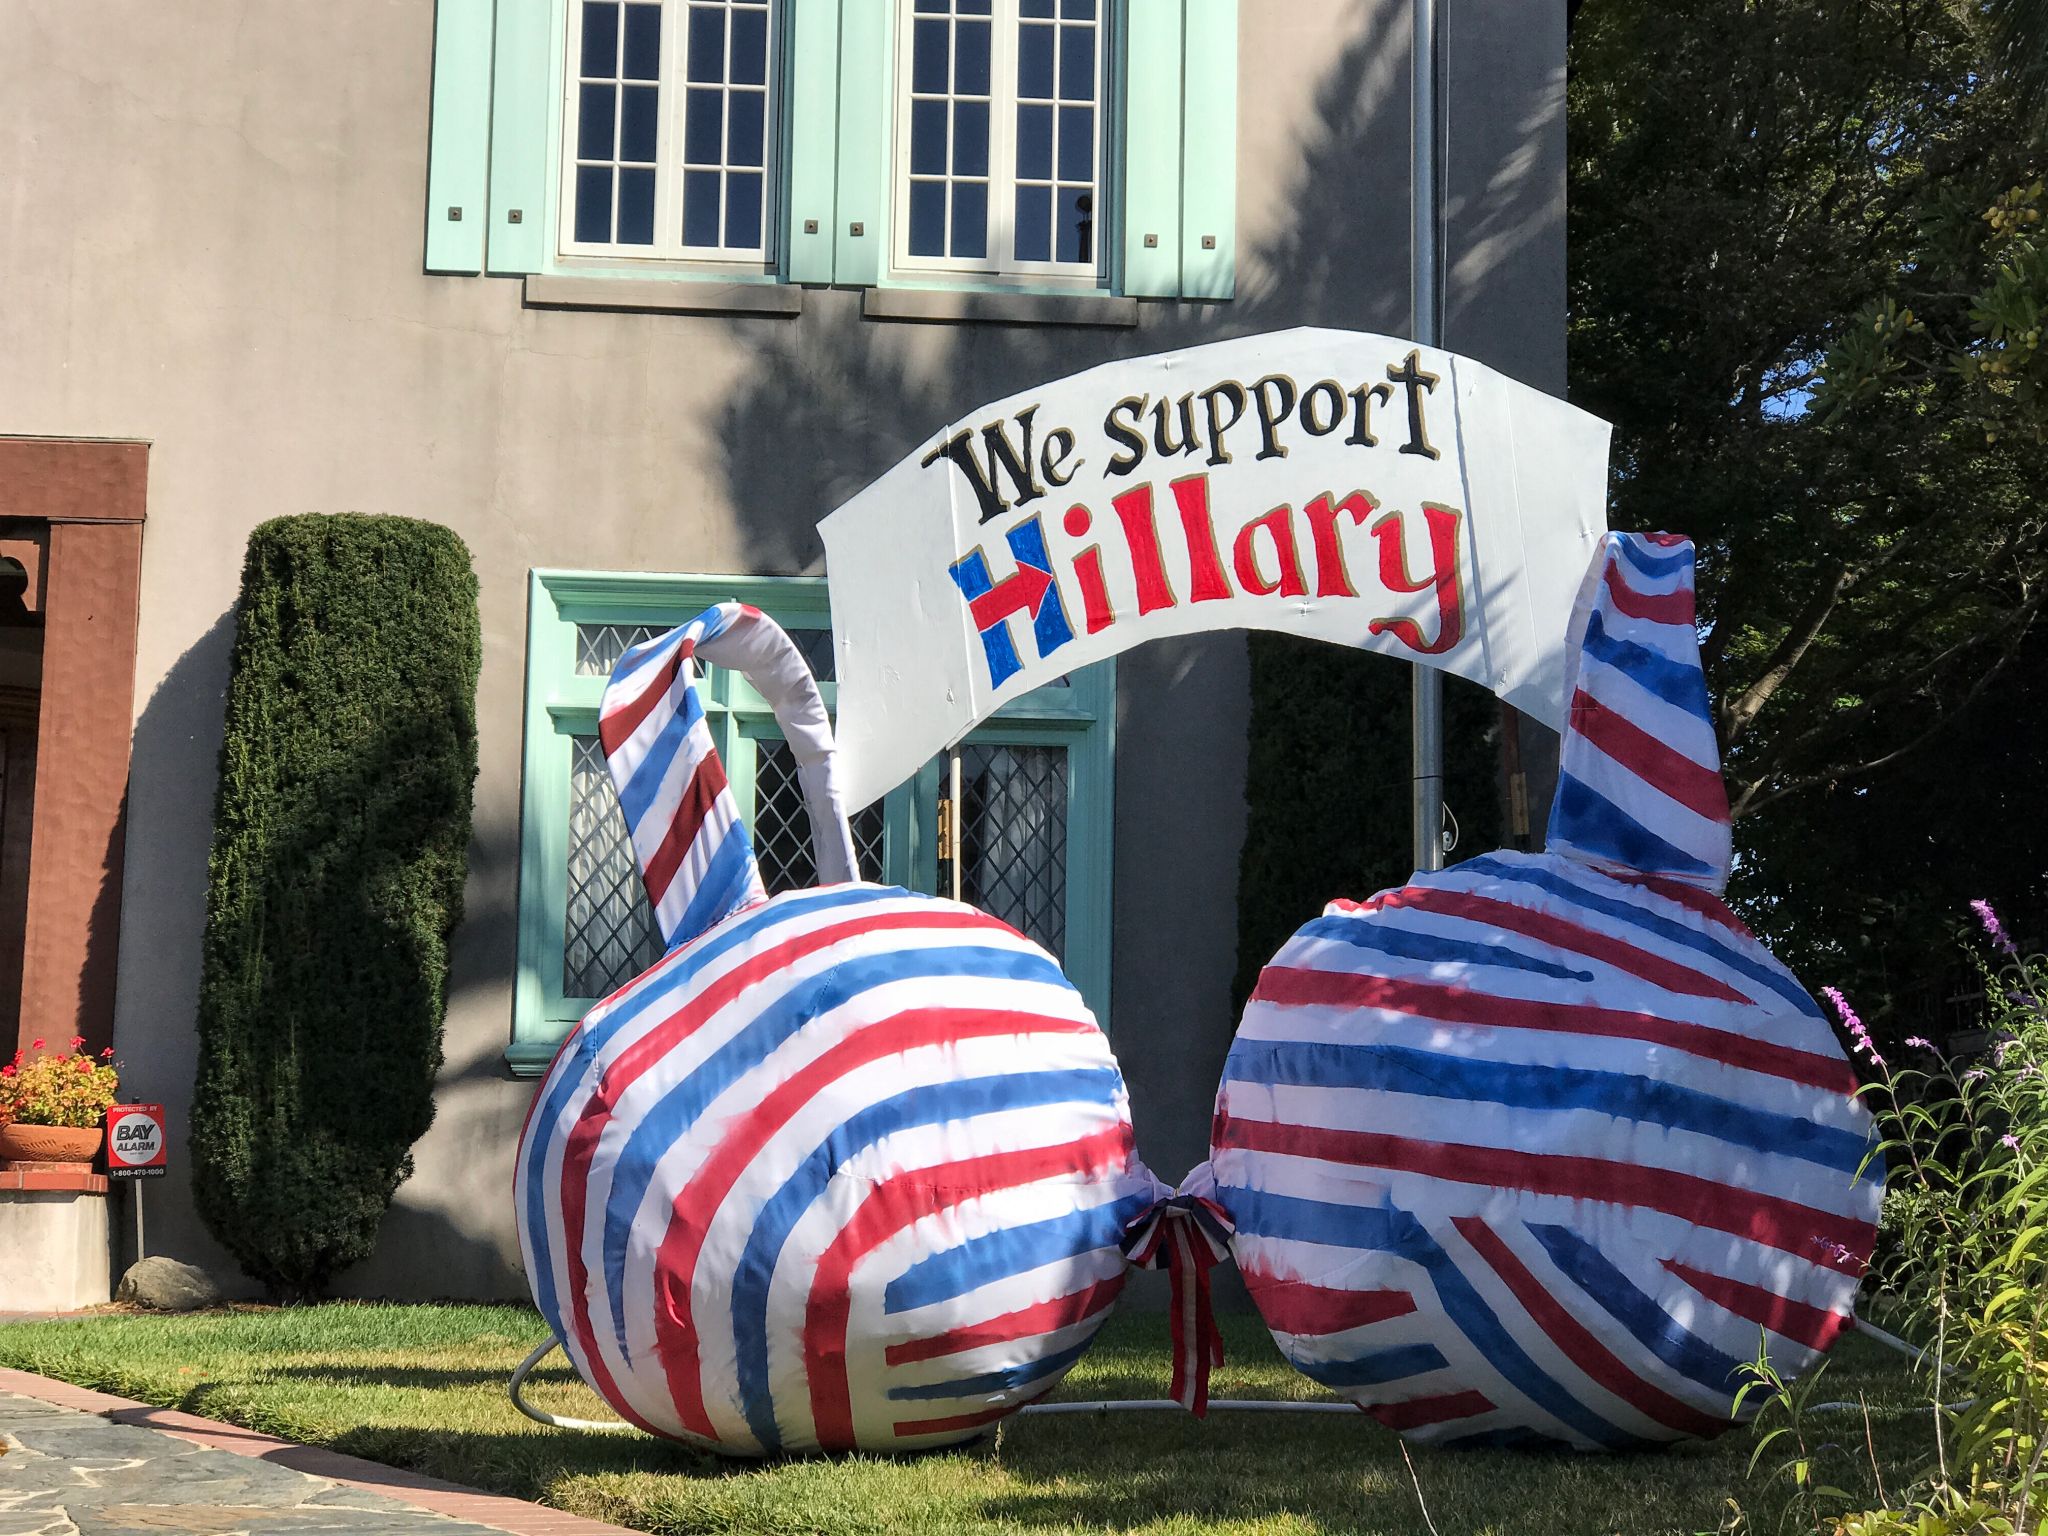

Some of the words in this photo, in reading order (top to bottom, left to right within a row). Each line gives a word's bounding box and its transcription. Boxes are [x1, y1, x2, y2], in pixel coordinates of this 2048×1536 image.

[922, 404, 1085, 525] We
[1103, 349, 1440, 479] support
[948, 472, 1464, 691] Hillary
[116, 1124, 155, 1140] BAY
[116, 1142, 155, 1152] ALARM
